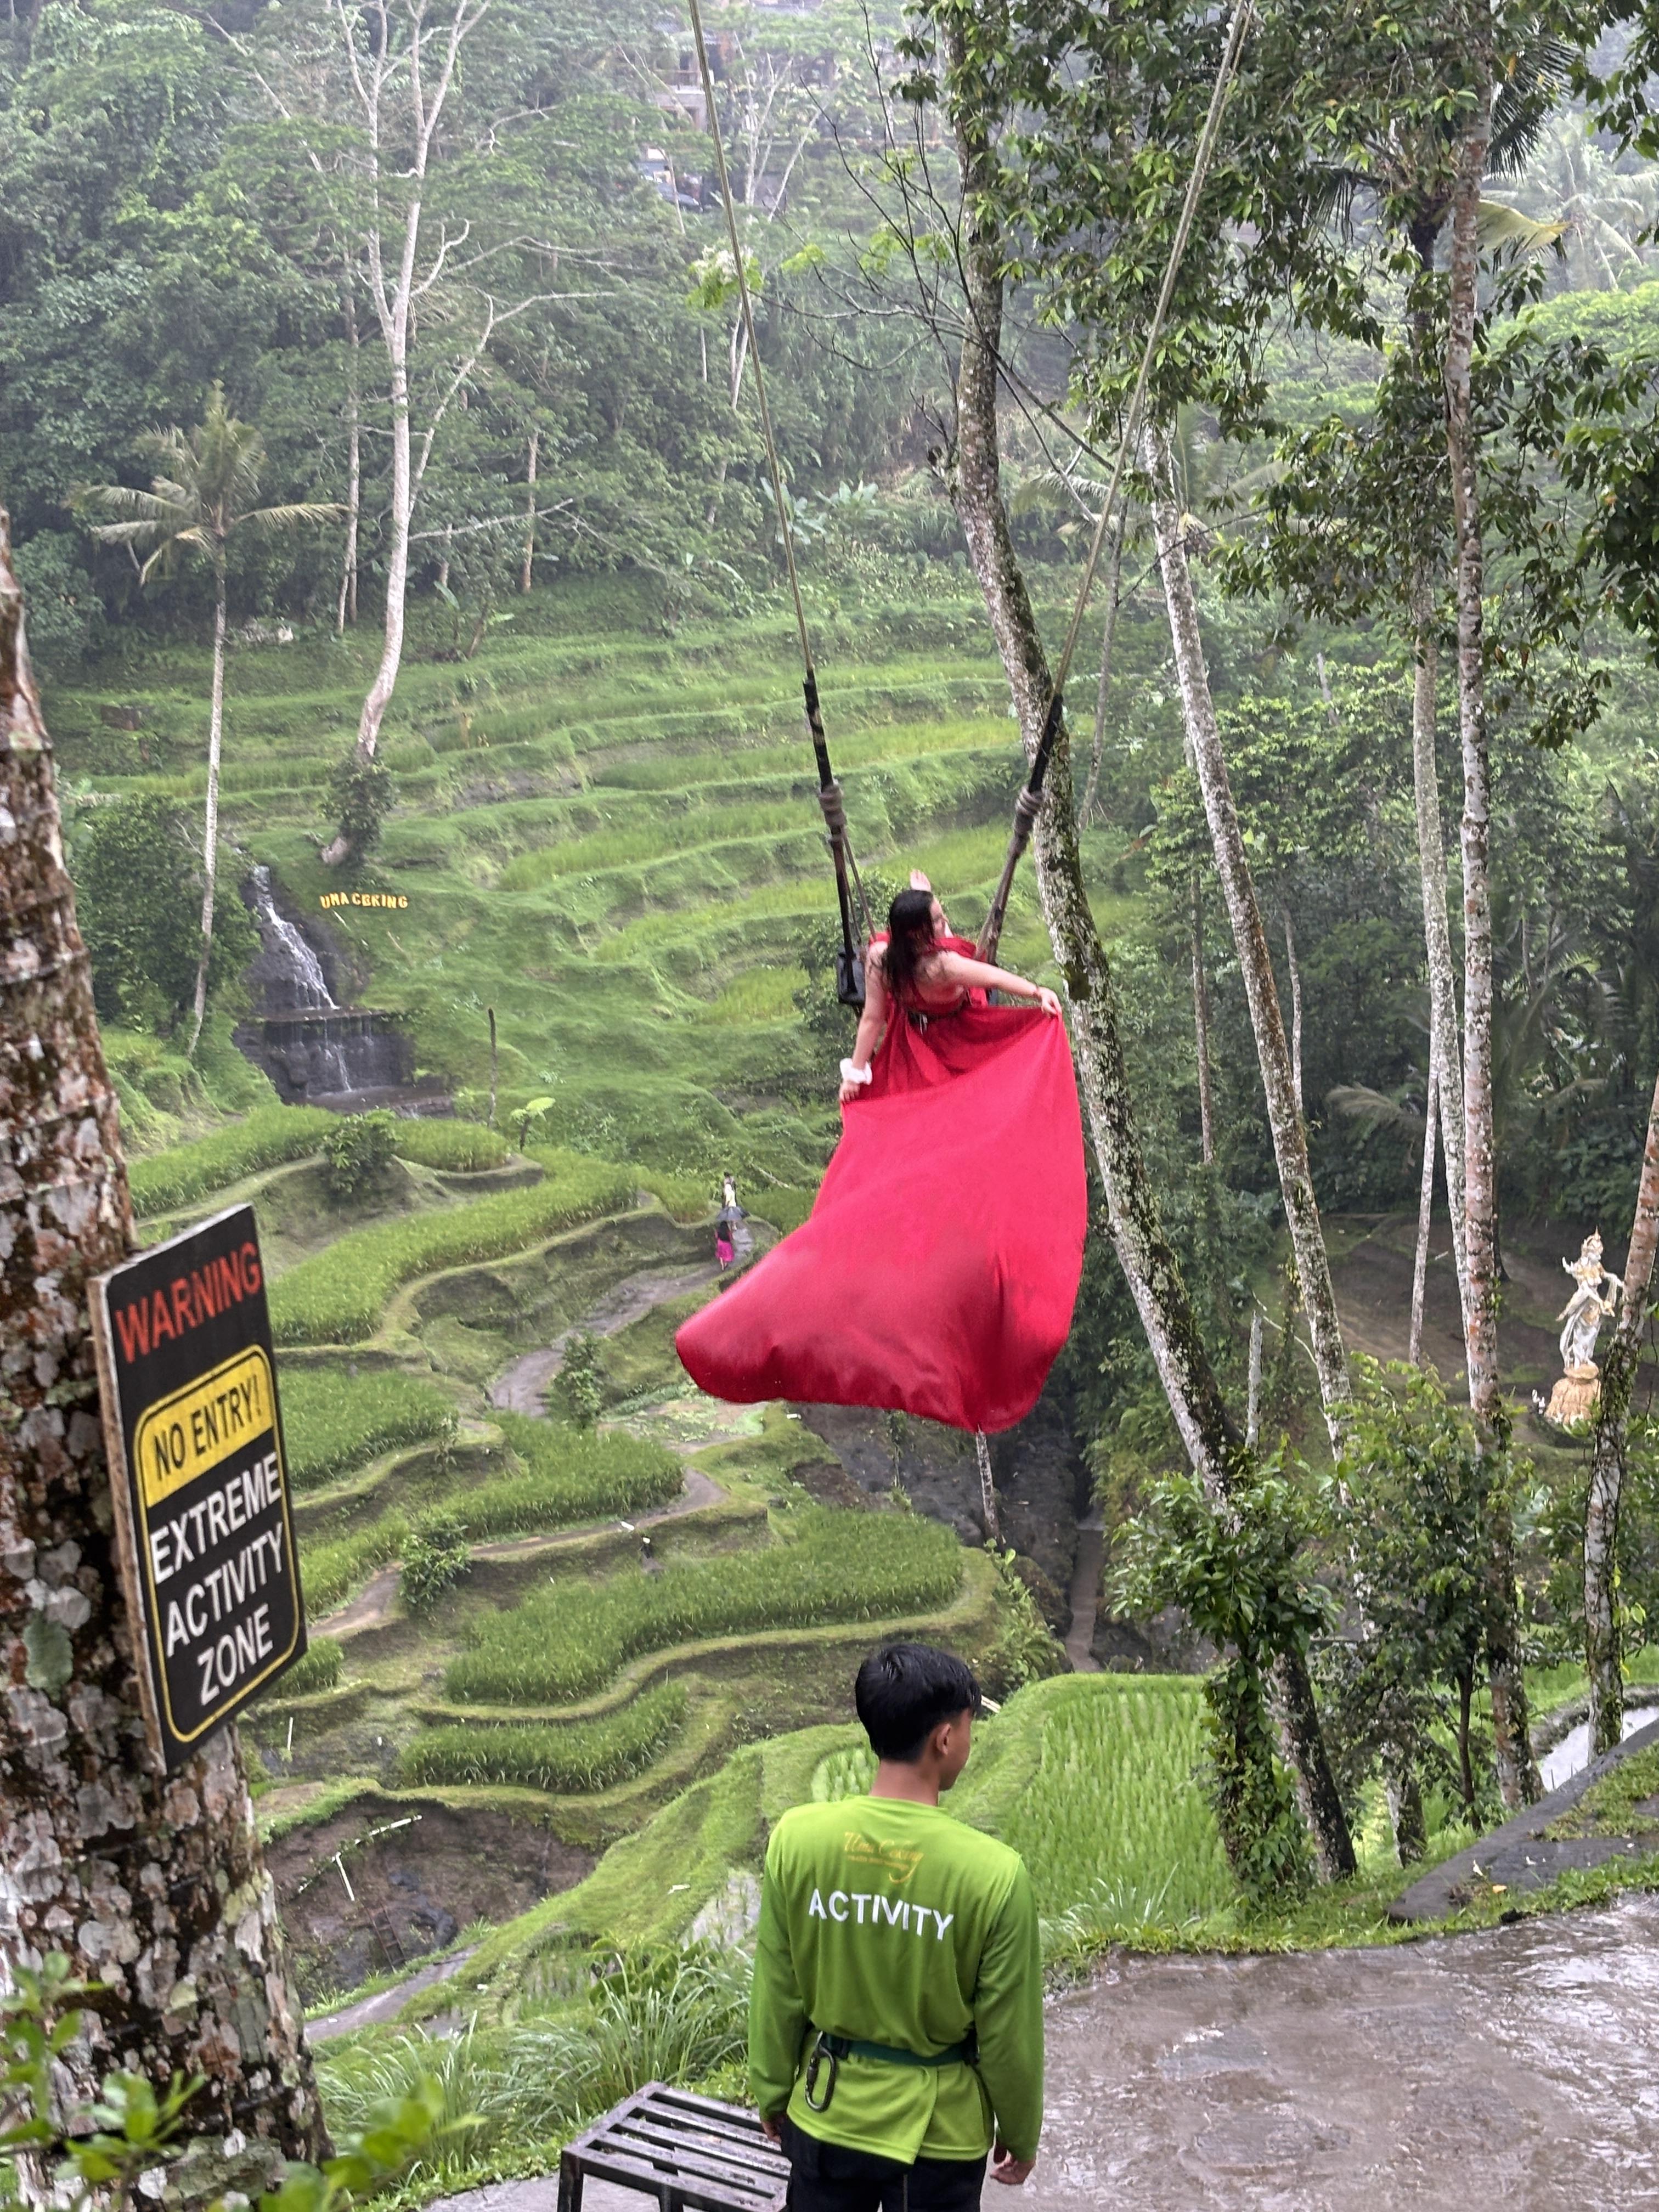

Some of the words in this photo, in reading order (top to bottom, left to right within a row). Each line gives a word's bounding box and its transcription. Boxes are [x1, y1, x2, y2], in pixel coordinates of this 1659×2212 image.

[320, 892, 349, 909] UMA
[116, 1242, 261, 1363] WARNING
[154, 1424, 185, 1480] NO
[191, 1374, 261, 1456] ENTRY!
[150, 1451, 282, 1585] EXTREME
[166, 1521, 283, 1658] ACTIVITY
[198, 1603, 274, 1707] ZONE
[809, 1888, 954, 1940] ACTIVITY
